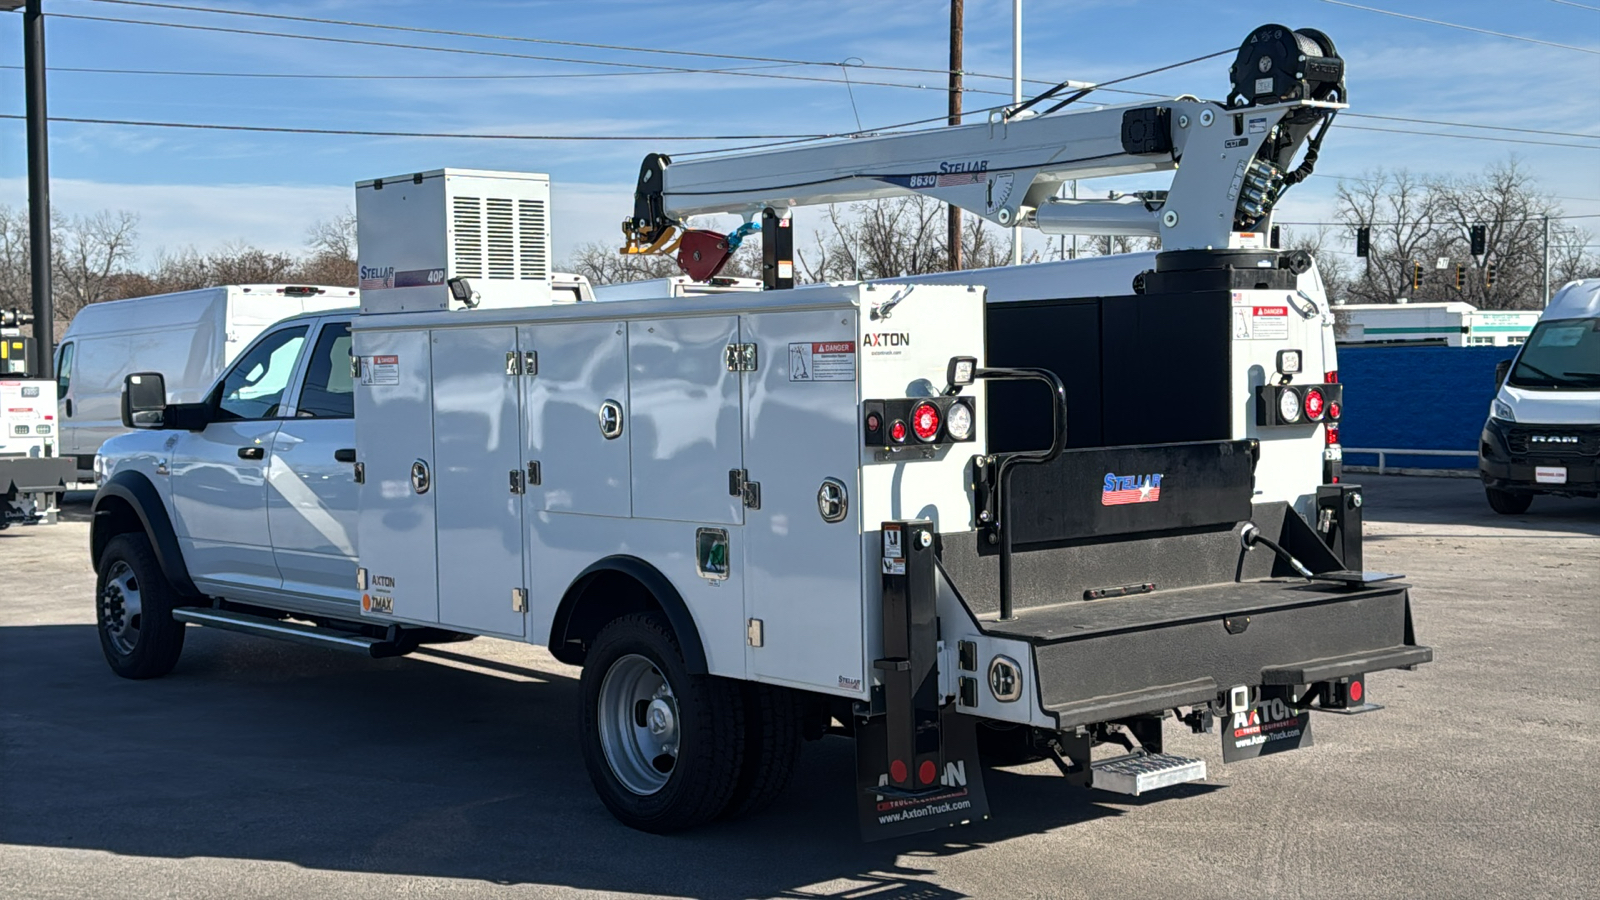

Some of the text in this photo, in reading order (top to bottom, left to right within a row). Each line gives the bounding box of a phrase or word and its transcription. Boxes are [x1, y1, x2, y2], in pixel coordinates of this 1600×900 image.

[940, 160, 987, 175] STELLAR
[909, 175, 935, 187] 8630
[361, 265, 394, 280] STELLAR
[427, 270, 444, 283] 40P
[863, 333, 909, 347] AXTON
[1531, 435, 1578, 443] RAM
[1103, 472, 1161, 492] STELLAR
[372, 575, 395, 588] AXTON
[372, 596, 392, 610] TMAX
[838, 675, 861, 685] STELLAR
[878, 799, 971, 825] www.AxtonTruck.com
